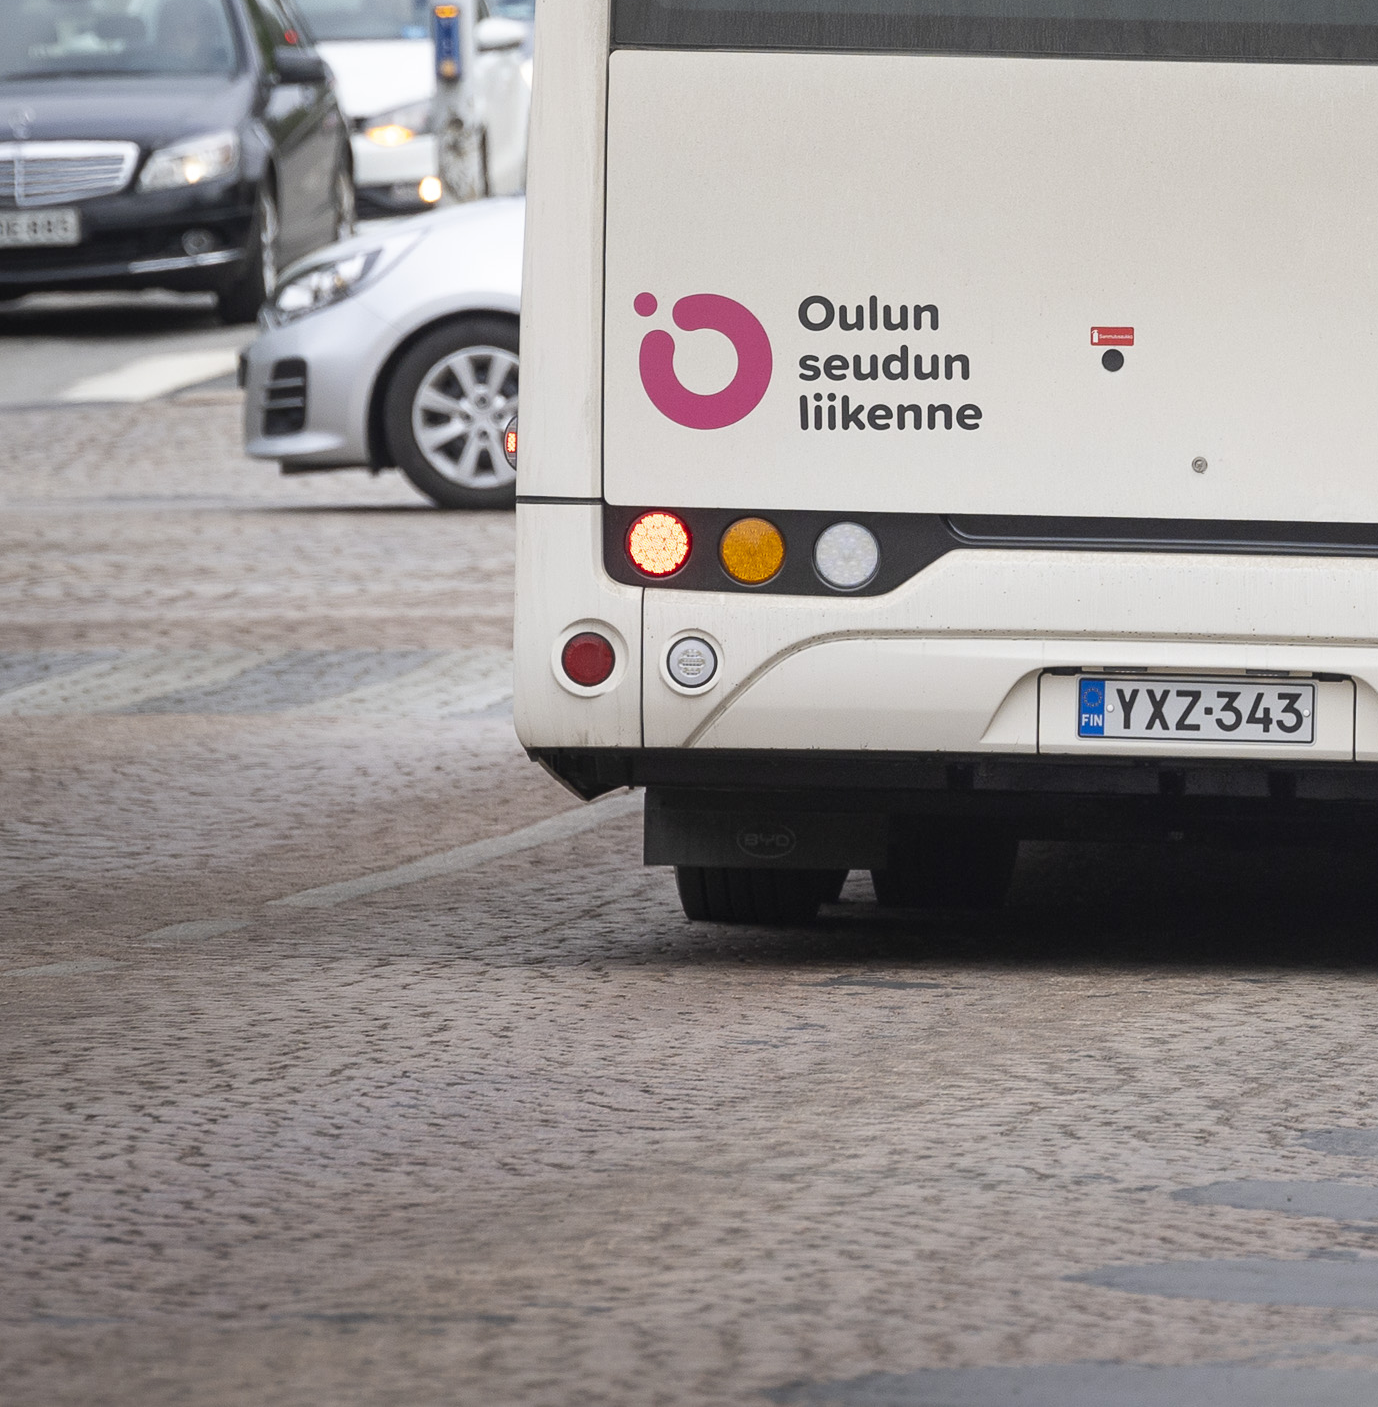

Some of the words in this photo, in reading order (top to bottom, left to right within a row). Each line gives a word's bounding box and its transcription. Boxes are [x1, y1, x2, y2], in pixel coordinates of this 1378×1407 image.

[798, 295, 939, 331] Oulun
[798, 344, 970, 381] seudun
[799, 392, 983, 431] liikenne
[1081, 713, 1103, 727] FIN
[1115, 687, 1304, 733] YXZ-343
